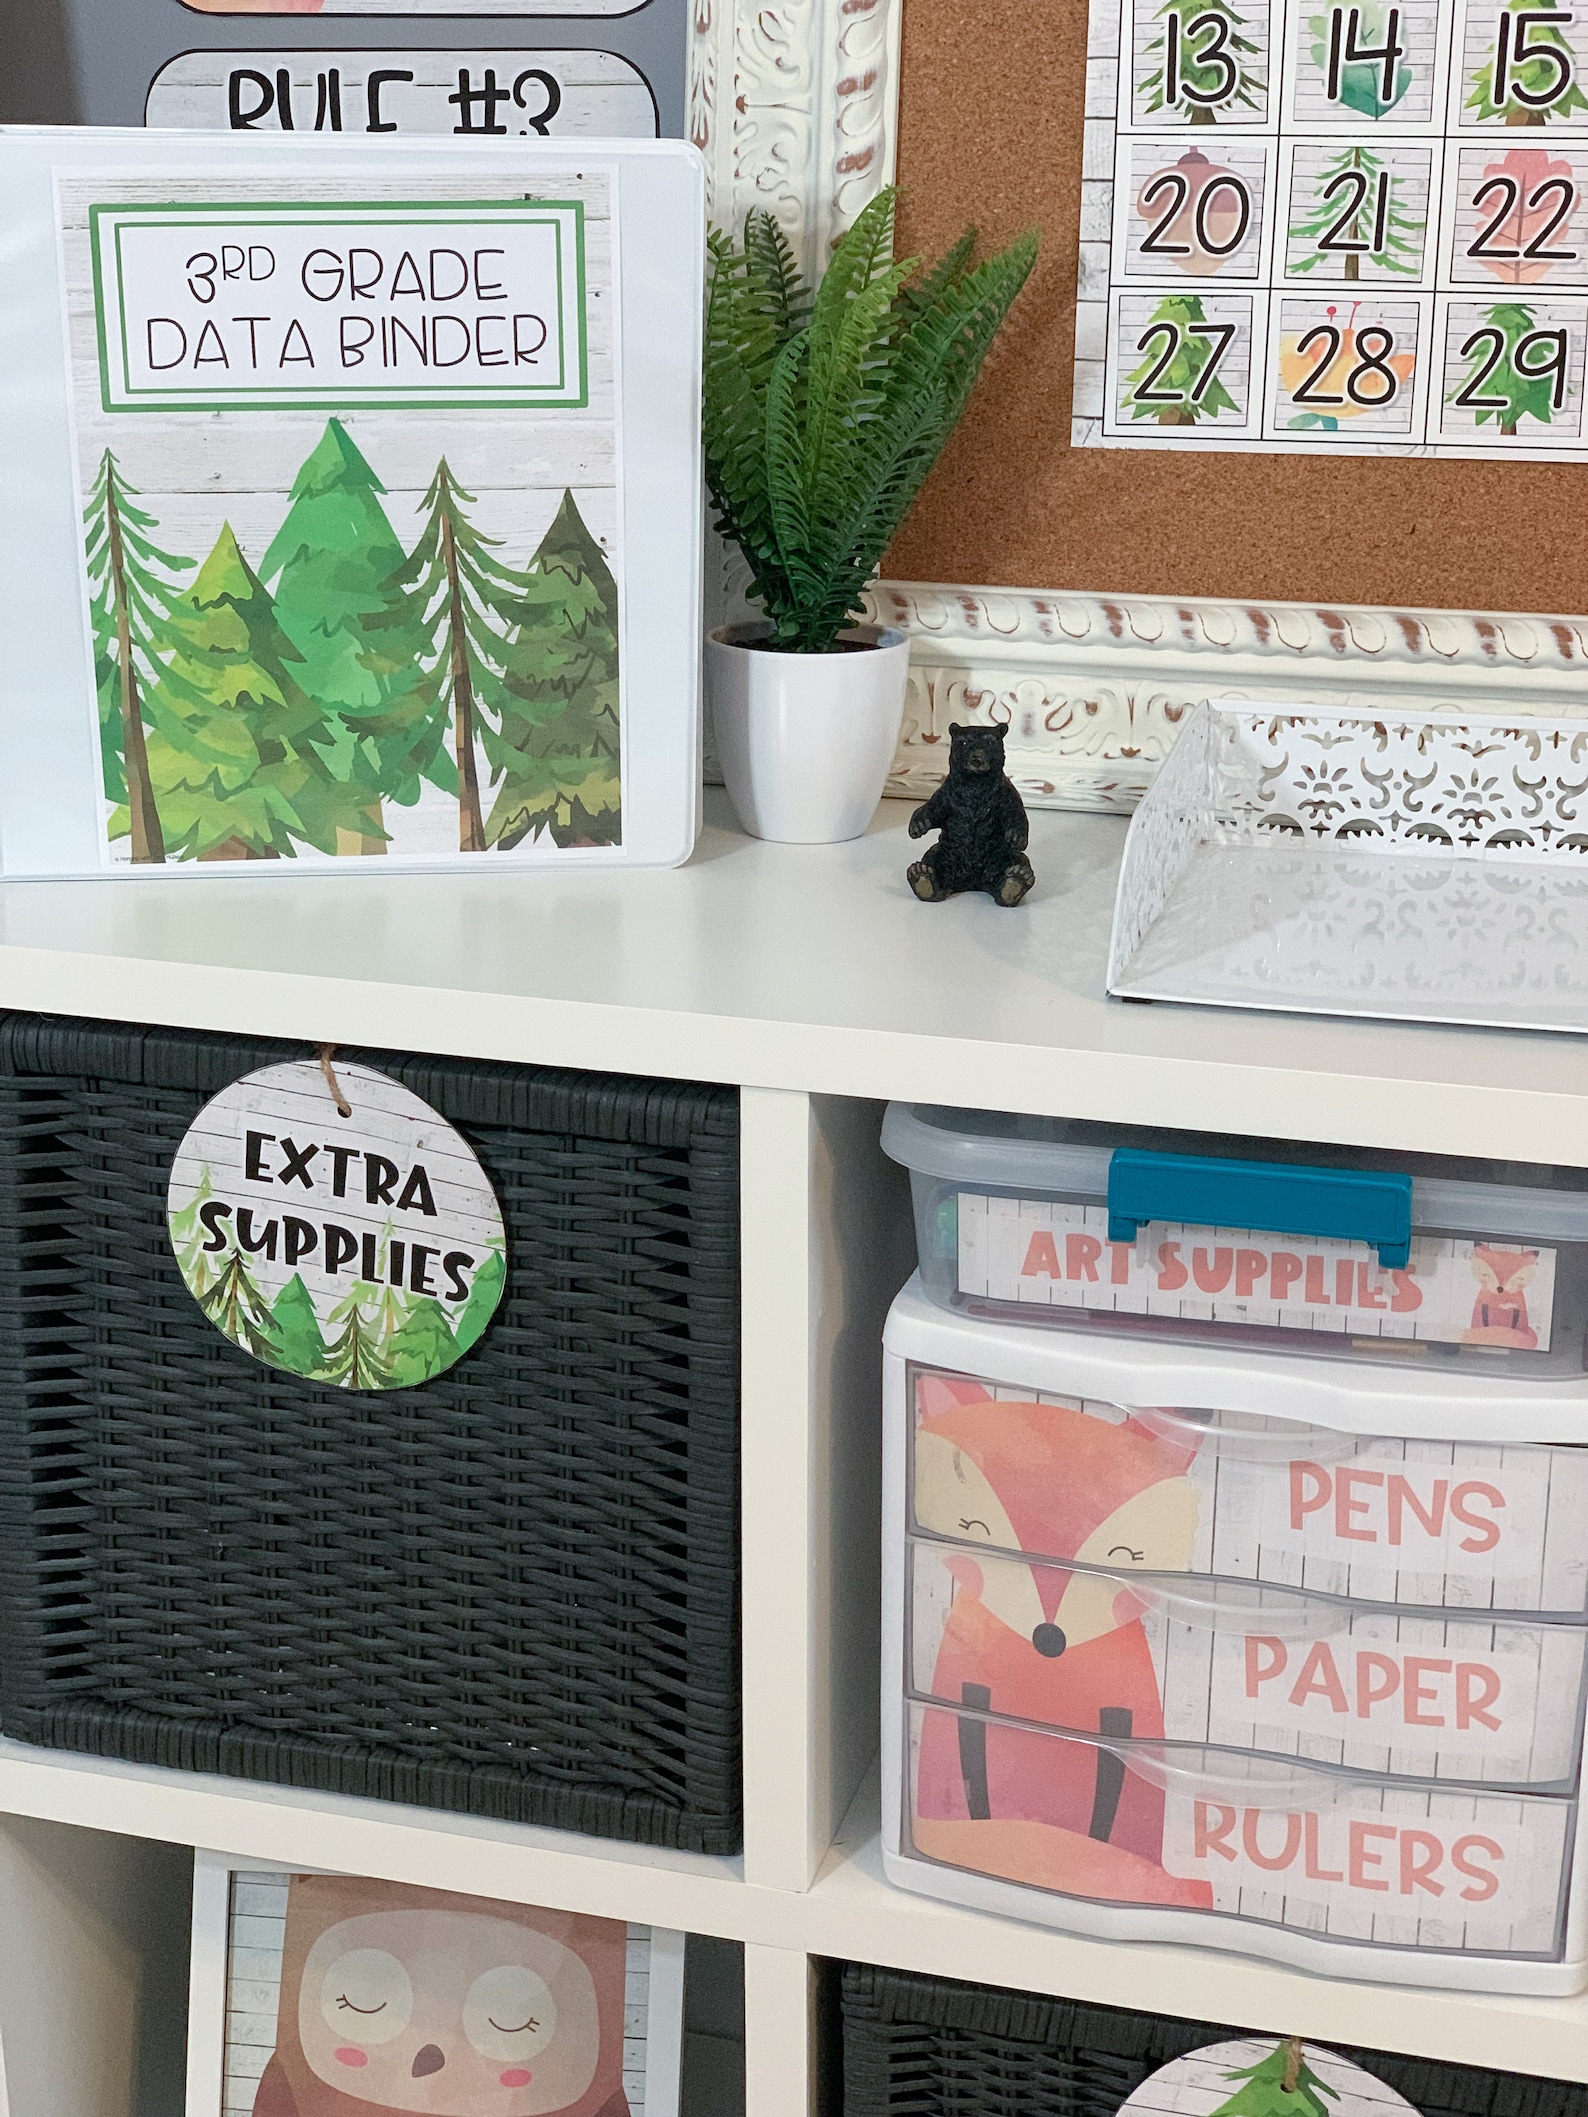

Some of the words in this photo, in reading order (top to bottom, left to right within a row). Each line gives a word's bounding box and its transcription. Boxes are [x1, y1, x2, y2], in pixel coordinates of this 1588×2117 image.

[1167, 14, 1237, 104] 13
[1328, 9, 1402, 100] 14
[1495, 12, 1572, 104] 15
[1140, 176, 1249, 254] 20
[1318, 172, 1387, 251] 21
[1467, 178, 1576, 258] 22
[186, 246, 275, 303] 3RD
[302, 249, 507, 301] GRADE
[148, 317, 314, 369] DATA
[340, 315, 546, 367] BINDER
[1134, 324, 1235, 400] 27
[1293, 326, 1395, 404] 28
[1456, 329, 1566, 408] 29
[245, 1130, 438, 1217] EXTRA
[200, 1201, 475, 1302] SUPPLIES
[1022, 1232, 1132, 1284] ART
[1158, 1244, 1422, 1312] SUPPLIES
[1290, 1461, 1505, 1552] PENS
[1246, 1636, 1500, 1730] PAPER
[1193, 1801, 1503, 1901] RULERS
